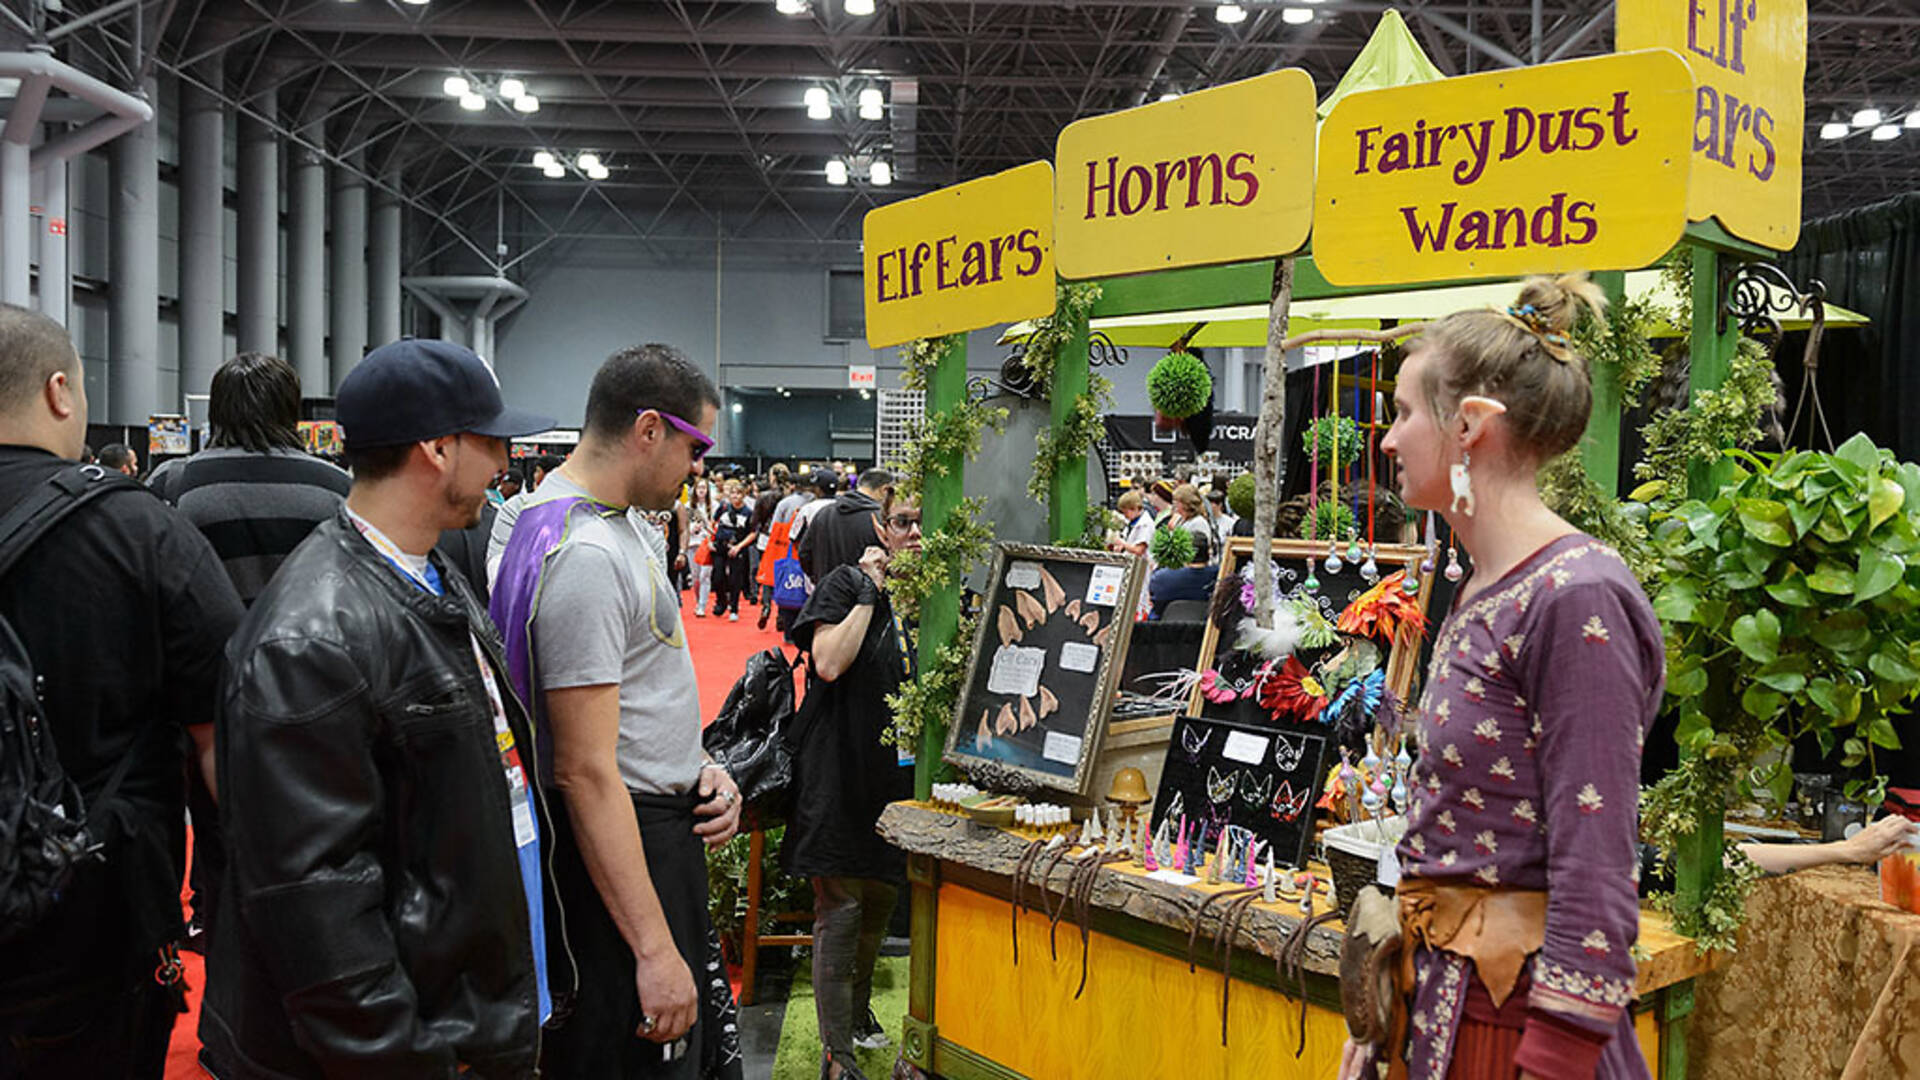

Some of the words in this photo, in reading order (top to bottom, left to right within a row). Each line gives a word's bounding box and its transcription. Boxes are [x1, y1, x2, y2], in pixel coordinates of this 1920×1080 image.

[1354, 119, 1495, 186] Fairy
[1499, 91, 1638, 161] Dust
[1692, 85, 1776, 181] ars
[1084, 152, 1260, 220] Horns
[1399, 193, 1598, 253] Wands
[877, 242, 931, 303] Elf
[935, 228, 1043, 291] Ears
[851, 372, 873, 382] Exit
